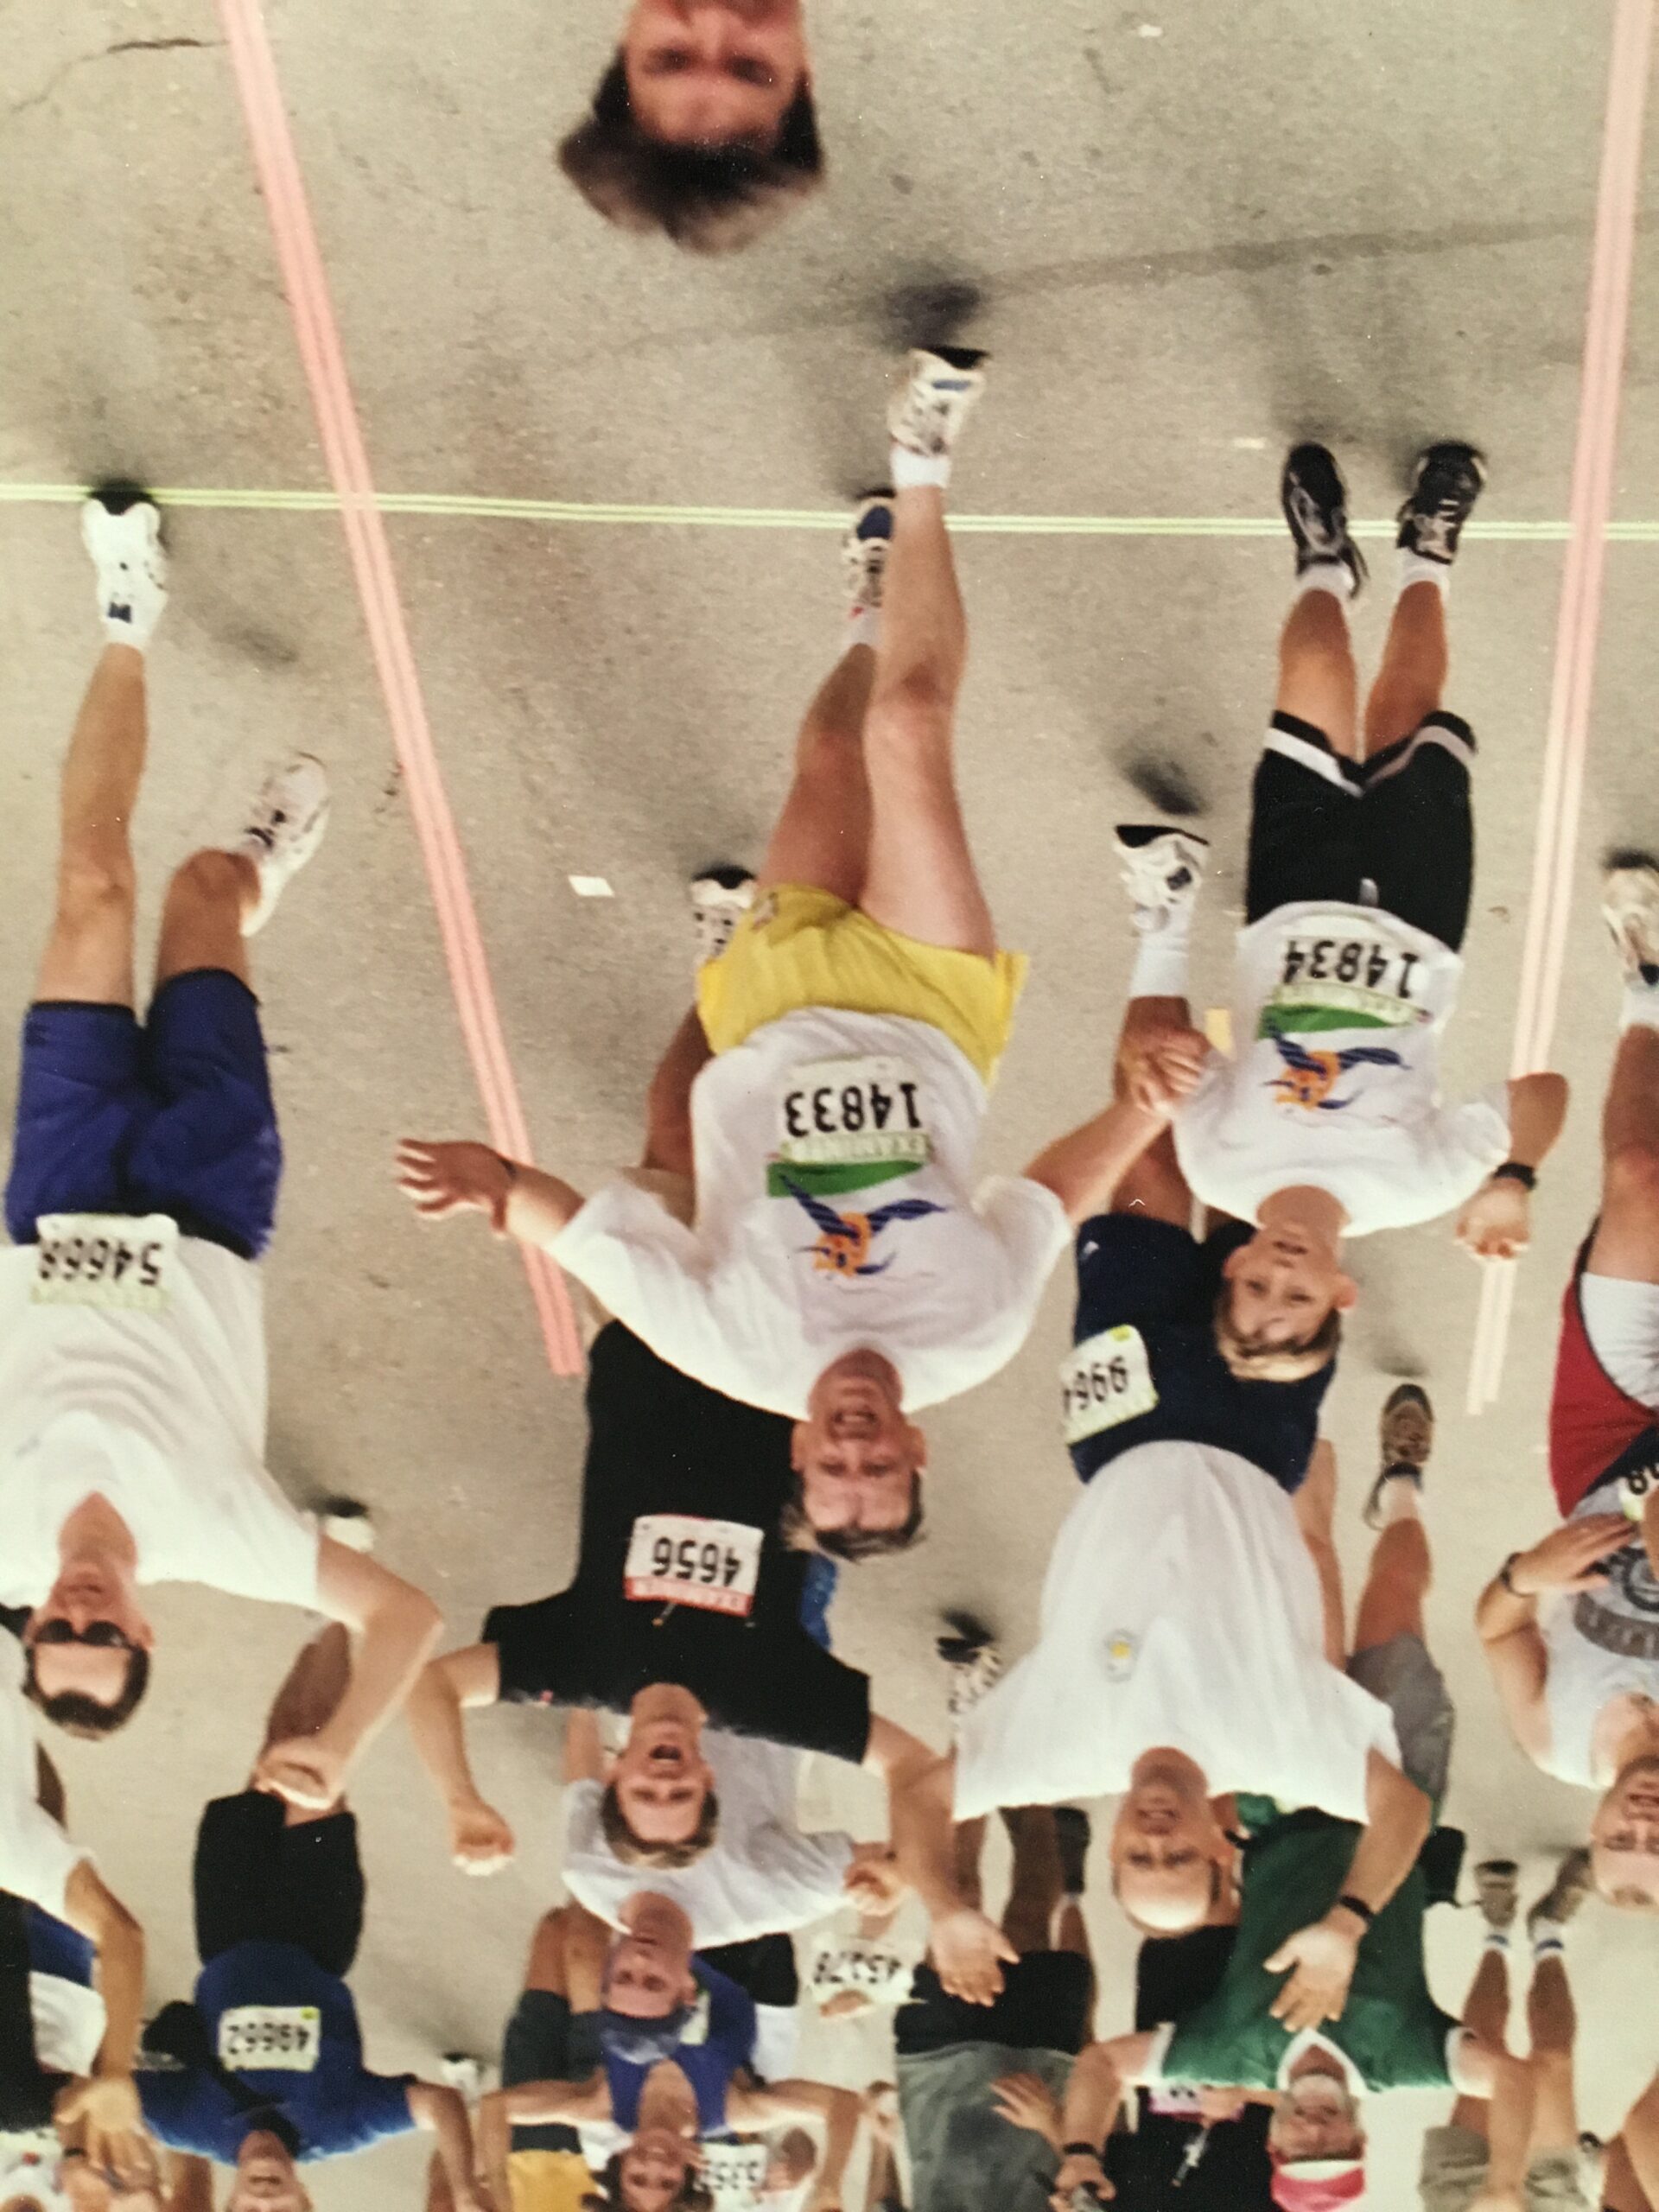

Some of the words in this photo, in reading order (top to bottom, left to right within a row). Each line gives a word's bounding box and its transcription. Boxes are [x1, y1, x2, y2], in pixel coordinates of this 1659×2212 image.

[1282, 940, 1421, 1000] 14834
[785, 1083, 922, 1138] 14833
[651, 1537, 741, 1587] 4656
